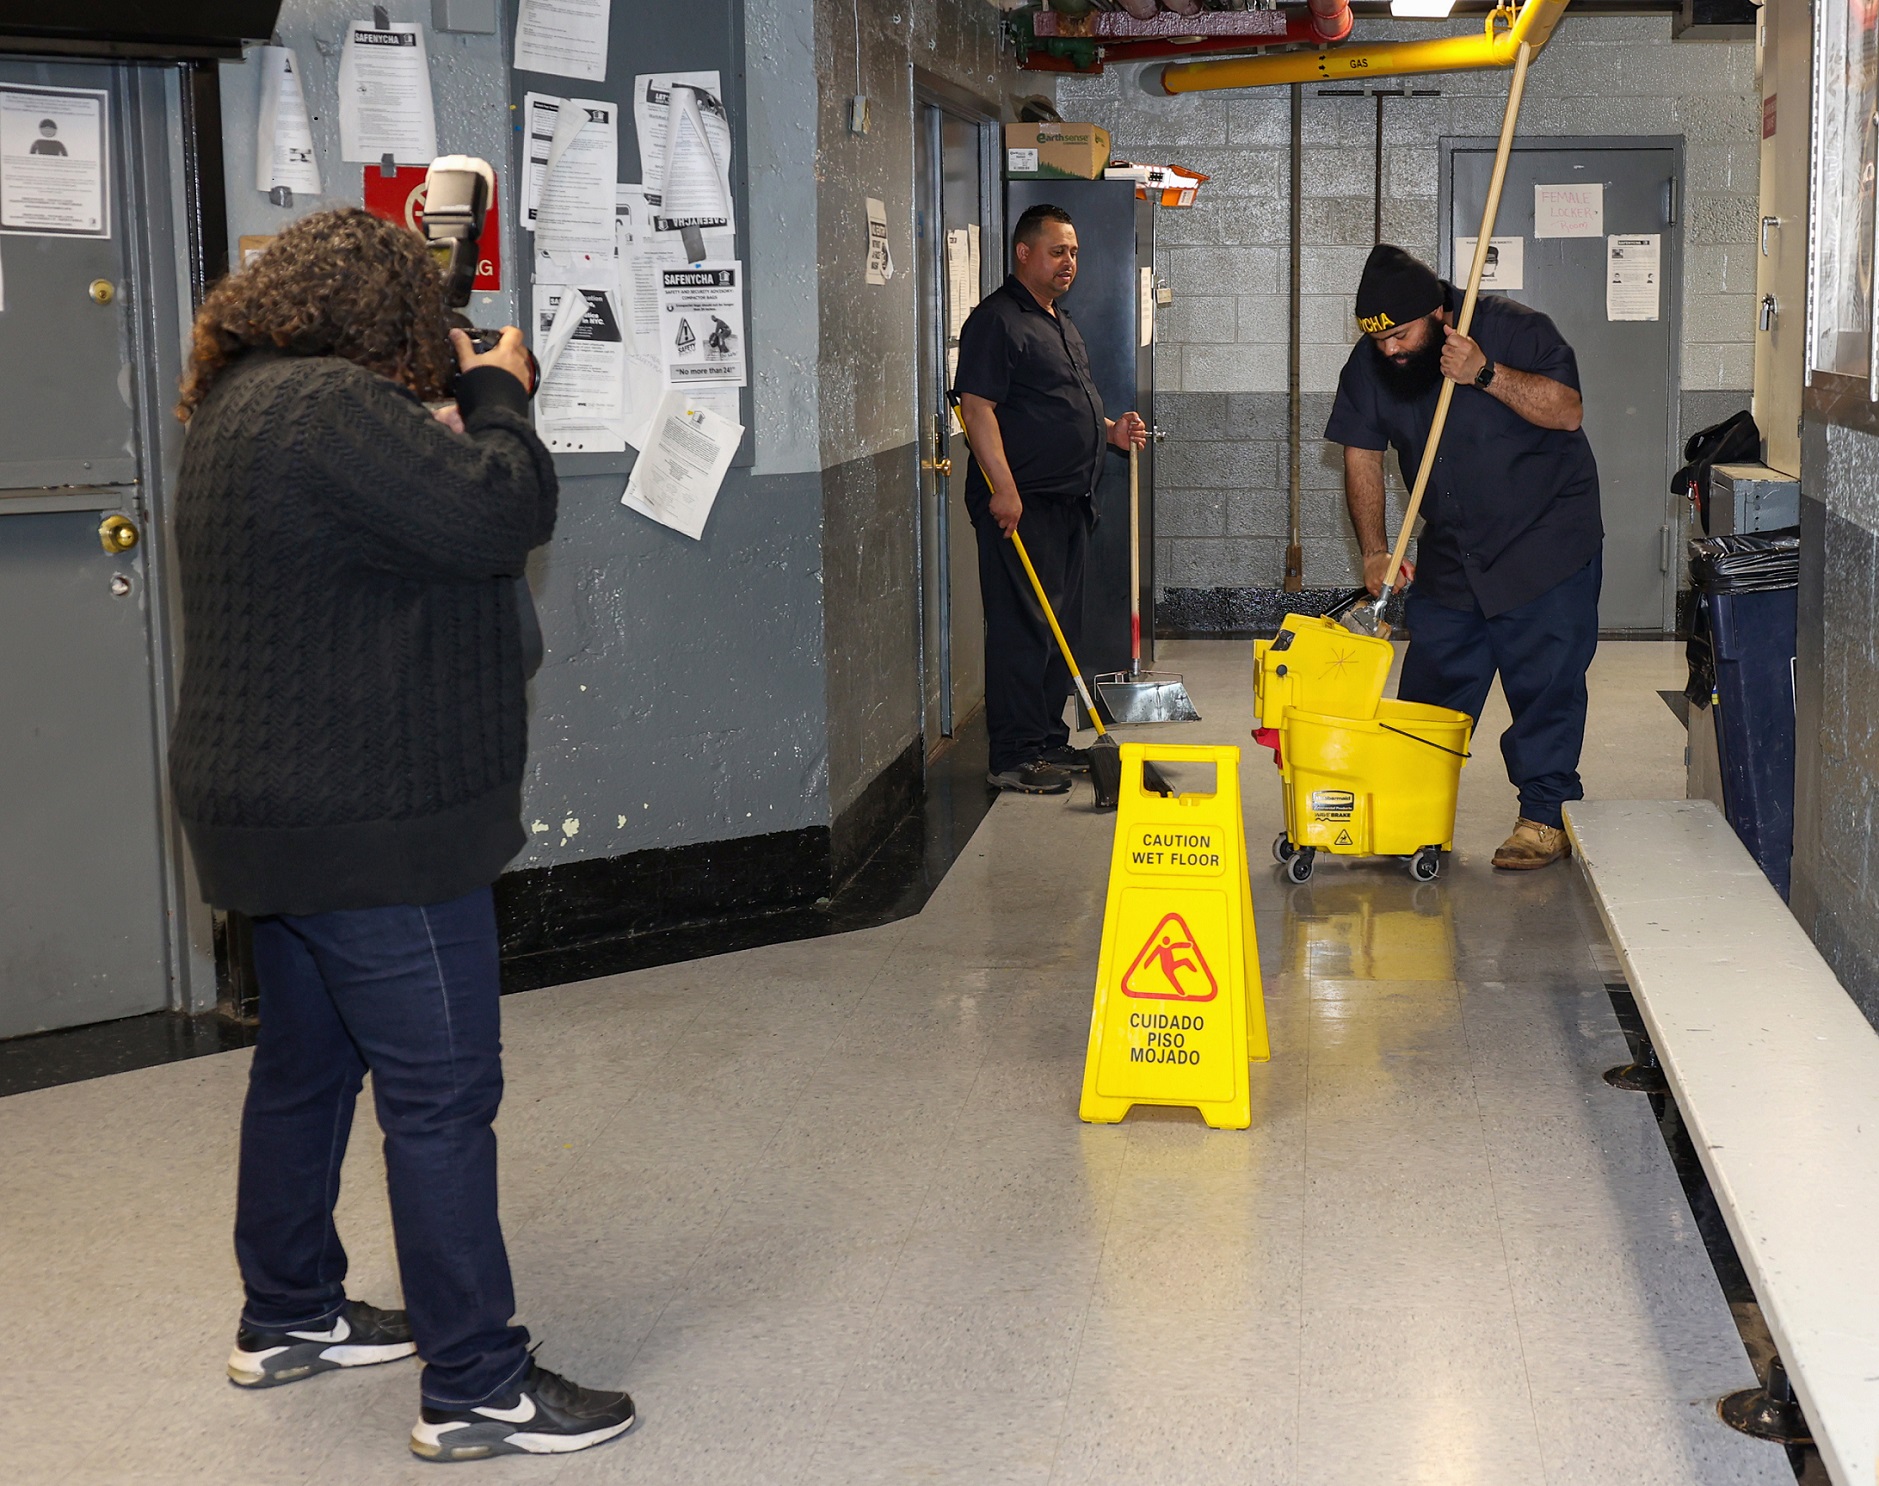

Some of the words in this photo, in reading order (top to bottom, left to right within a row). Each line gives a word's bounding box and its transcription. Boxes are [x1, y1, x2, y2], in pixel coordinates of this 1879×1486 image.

[355, 33, 399, 44] SAFENYCHA
[1350, 58, 1368, 68] GAS
[1036, 132, 1088, 143] earthsense
[1542, 191, 1592, 204] FEMALE
[1551, 207, 1593, 220] LOCKER
[664, 273, 714, 285] SAFENYCHA
[690, 367, 708, 375] more
[709, 366, 722, 374] than
[1142, 833, 1211, 848] CAUTION
[1132, 851, 1163, 865] WET
[1170, 852, 1219, 867] FLOOR
[1130, 1013, 1204, 1031] CUIDADO
[1147, 1032, 1185, 1048] PISO
[1130, 1049, 1200, 1065] MOJADO
